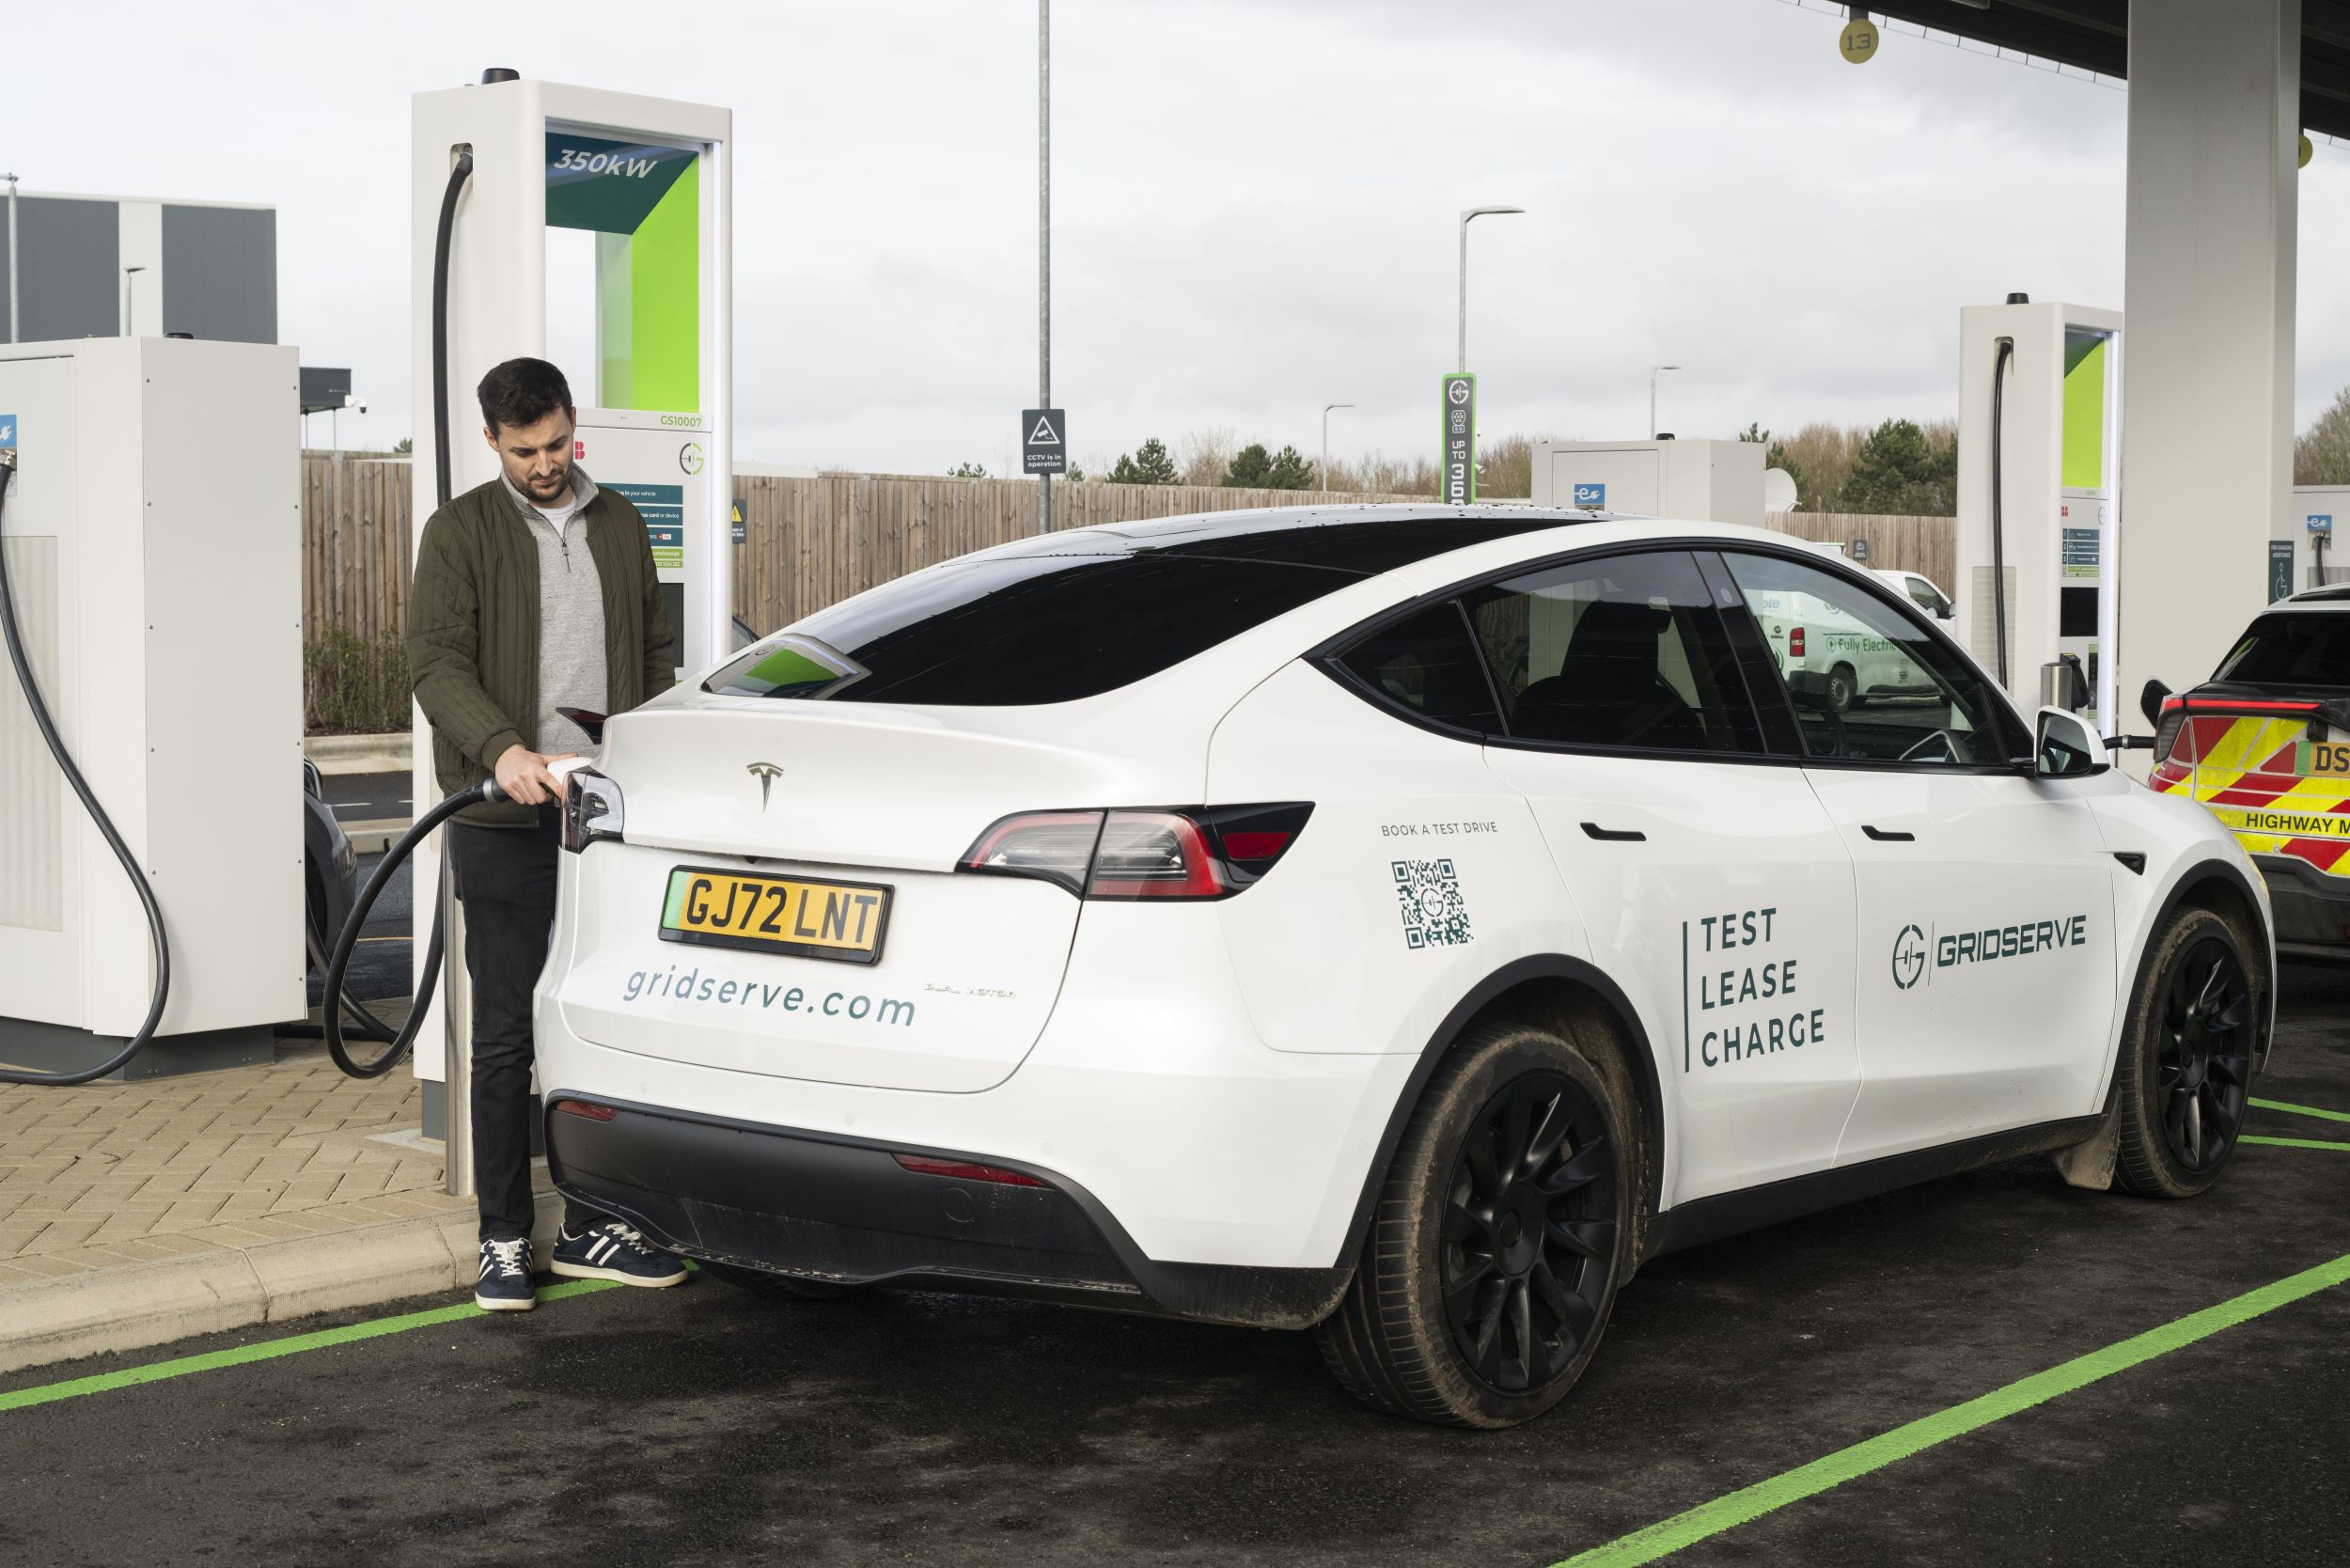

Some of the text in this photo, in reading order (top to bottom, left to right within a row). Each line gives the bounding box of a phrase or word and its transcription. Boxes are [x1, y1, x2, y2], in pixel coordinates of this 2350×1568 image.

[1847, 34, 1872, 51] 13
[553, 149, 658, 179] 350kW
[660, 415, 702, 428] GS10007
[1451, 440, 1465, 449] UP
[1451, 450, 1465, 460] TO
[1839, 637, 1860, 654] Fully
[1381, 822, 1498, 837] BOOK A TEST DRIVE
[2246, 813, 2334, 833] HIGHWAY
[685, 878, 879, 944] GJ72 LNT
[1700, 907, 1777, 952] TEST
[1936, 915, 2087, 967] GRIDSERVE
[622, 964, 916, 1027] gridserve.com
[1700, 960, 1797, 1011] LEASE
[1700, 1009, 1825, 1068] CHARGE
